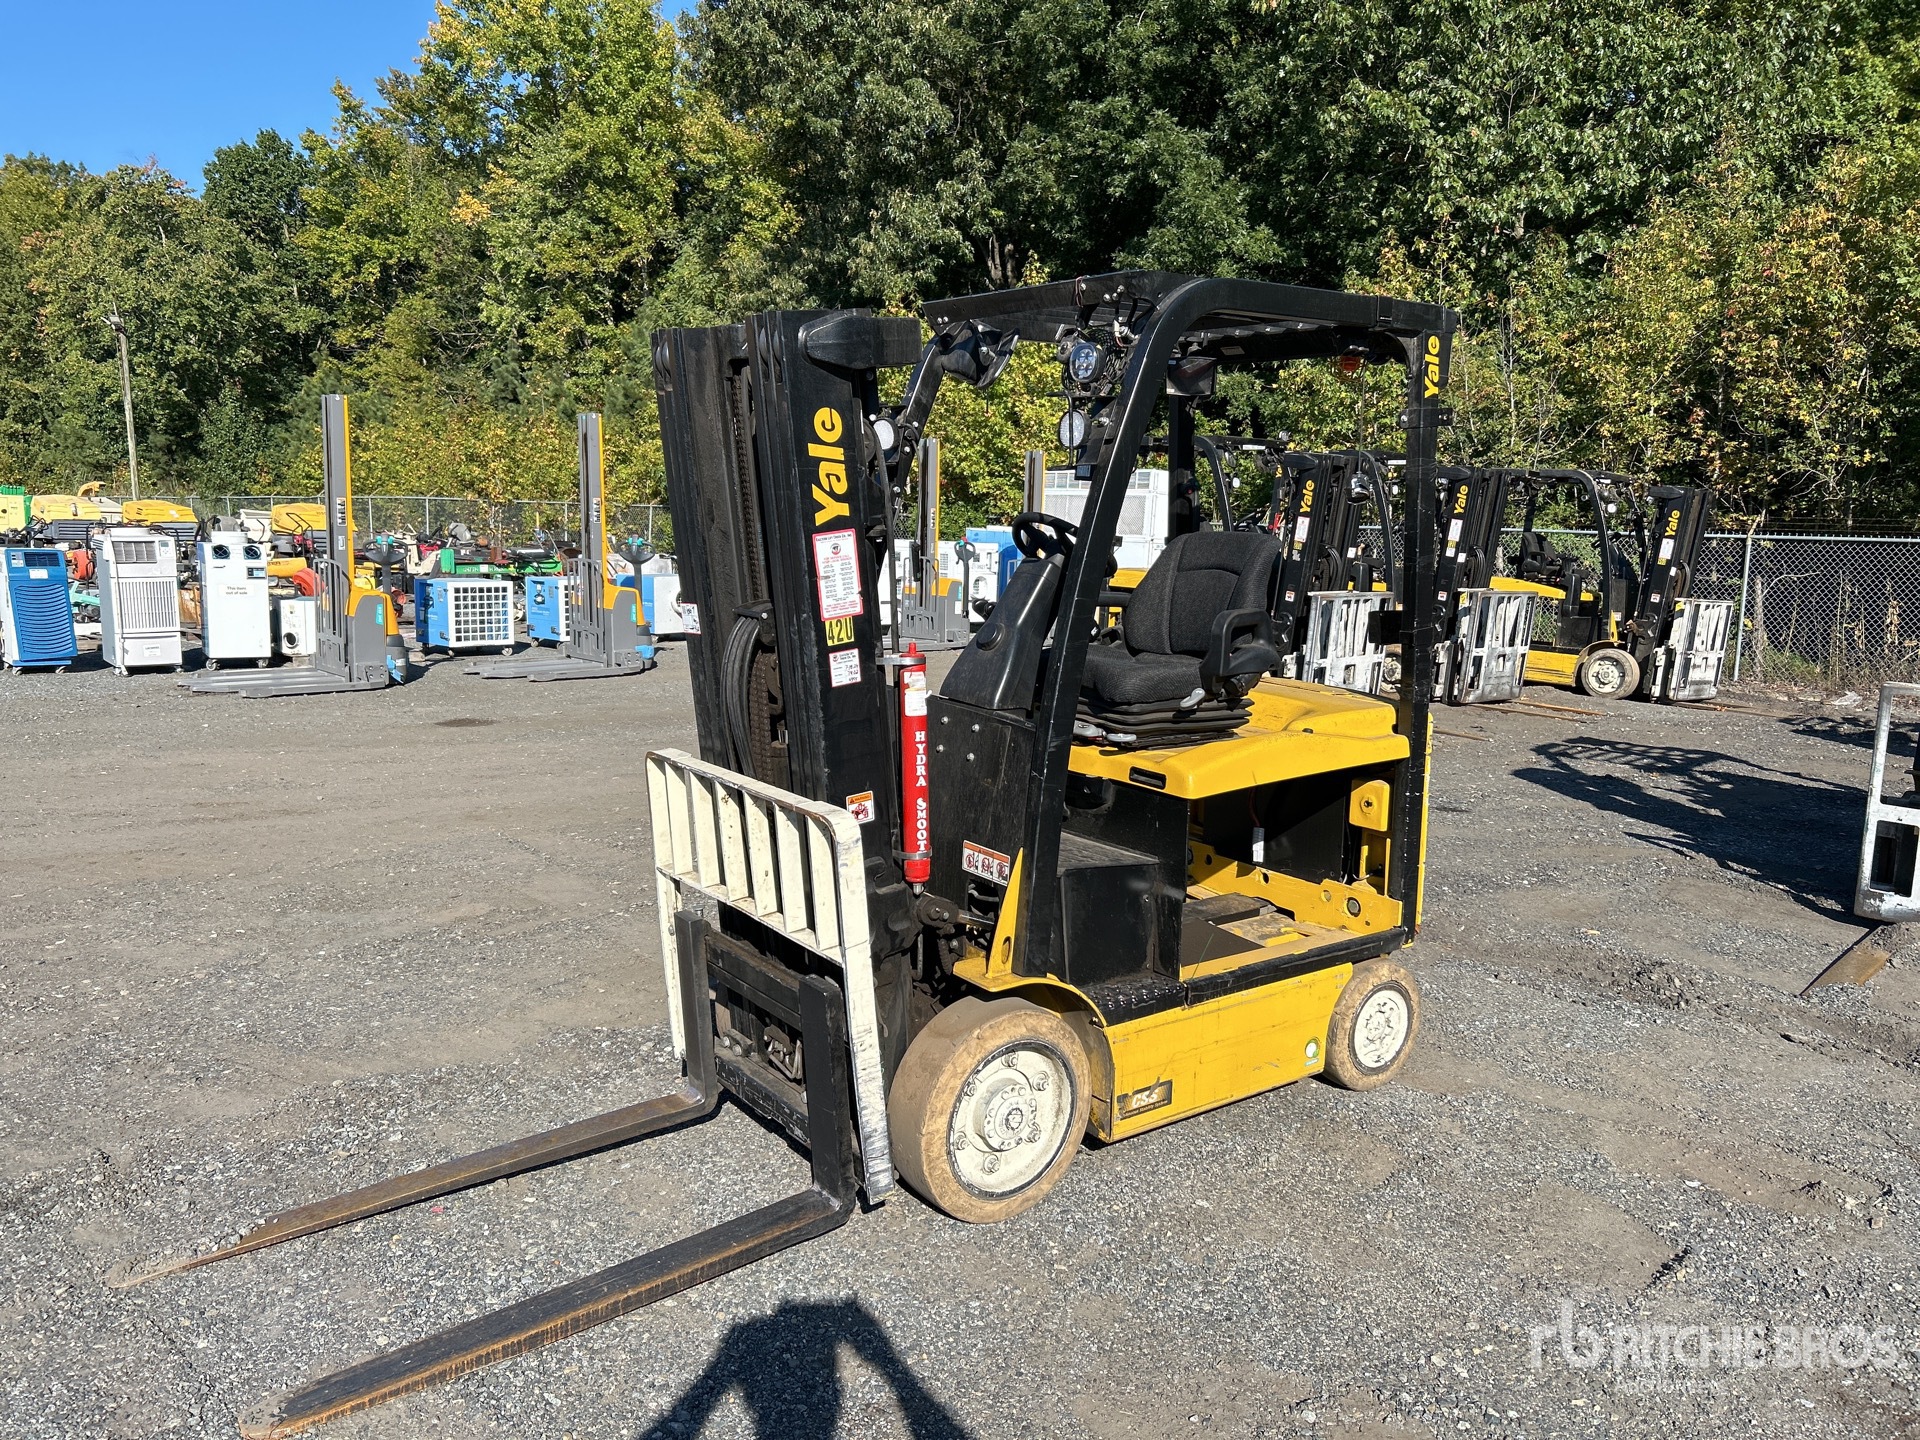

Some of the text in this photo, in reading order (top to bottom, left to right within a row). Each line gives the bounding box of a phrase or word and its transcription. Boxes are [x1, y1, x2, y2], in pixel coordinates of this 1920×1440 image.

[1424, 335, 1440, 399] Yale
[808, 407, 849, 527] Yale
[1300, 479, 1315, 513] Yale
[1454, 484, 1469, 514] Yale
[1664, 509, 1681, 537] Yale
[915, 730, 927, 787] HYDRA
[916, 797, 928, 860] SMOOT
